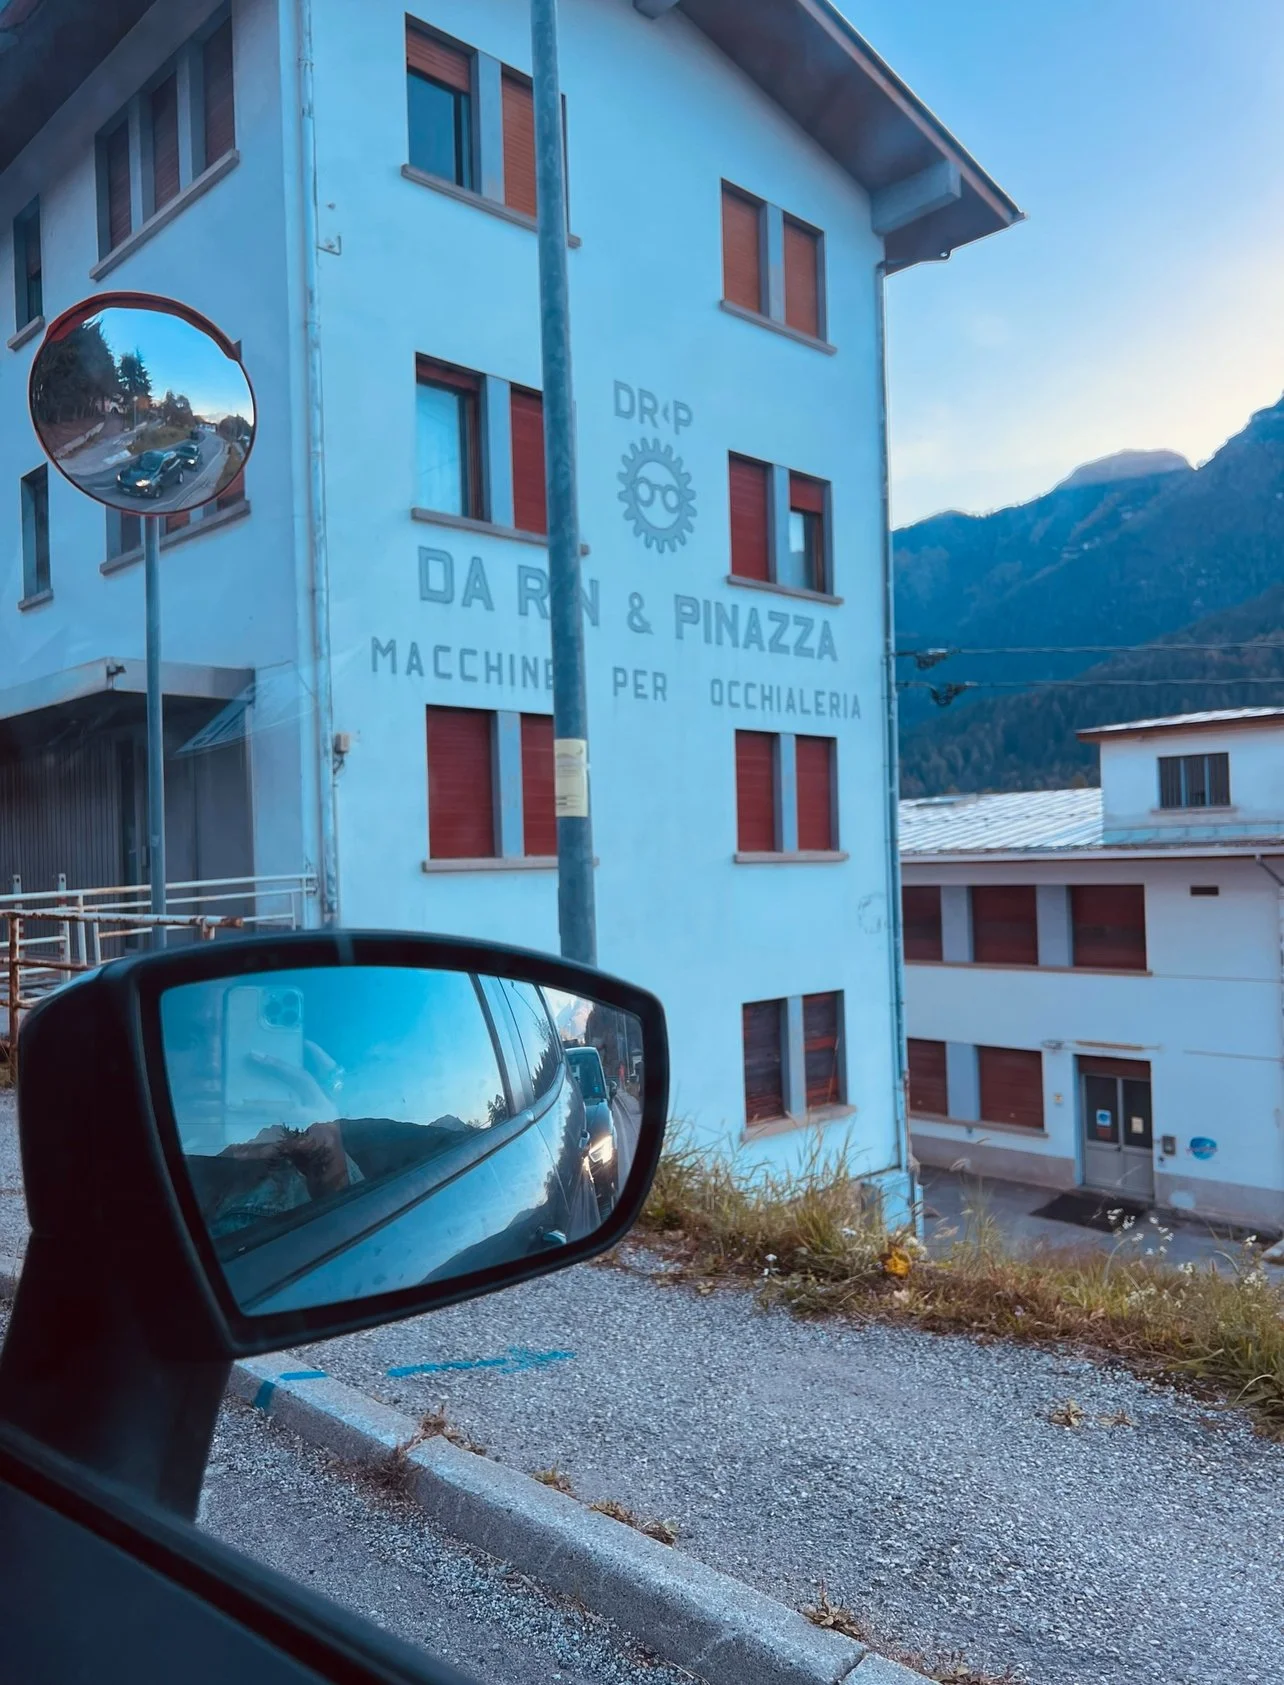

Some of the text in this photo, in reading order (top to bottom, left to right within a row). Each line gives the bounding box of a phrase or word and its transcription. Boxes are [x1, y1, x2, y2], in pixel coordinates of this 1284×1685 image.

[418, 545, 838, 662] DA RN & PINAZZA
[612, 666, 667, 702] PER
[710, 678, 862, 719] OCCHIALERIA
